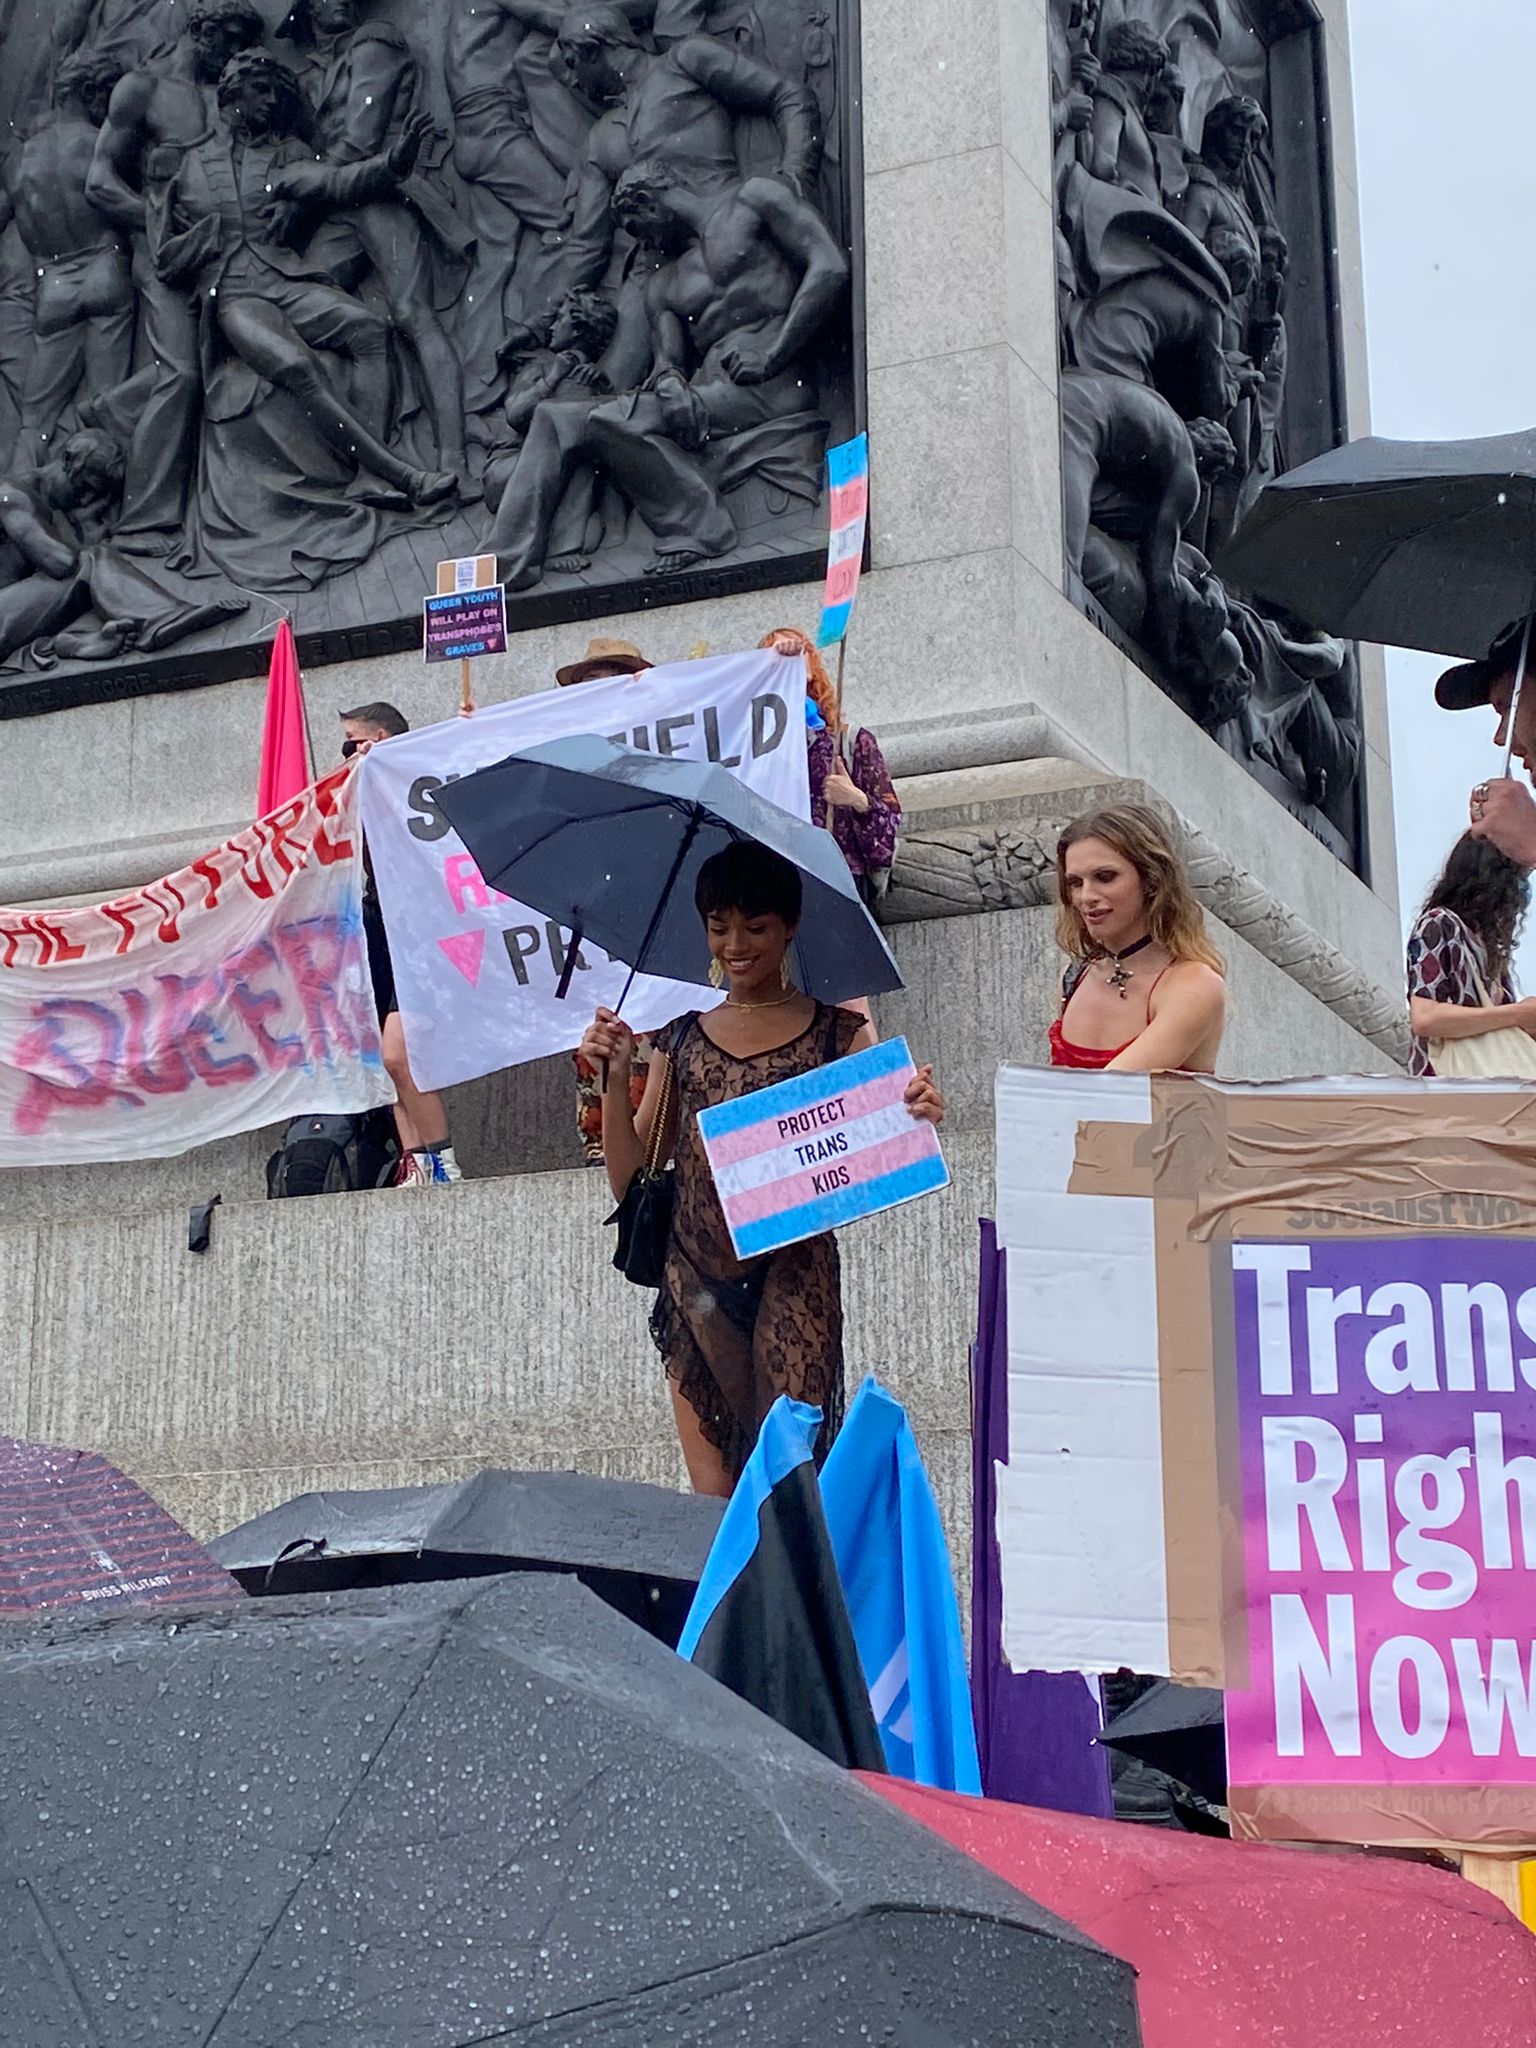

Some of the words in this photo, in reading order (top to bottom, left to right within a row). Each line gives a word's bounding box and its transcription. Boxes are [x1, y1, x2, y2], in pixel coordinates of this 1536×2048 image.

[430, 597, 461, 611] QUEER
[465, 591, 498, 604] YOUTH
[431, 615, 454, 626] WILL
[457, 610, 480, 622] PLAY
[483, 607, 498, 618] ON
[445, 641, 486, 656] GRAVES
[101, 767, 354, 954] FUTURE
[777, 1098, 847, 1139] PROTECT
[795, 1132, 849, 1167] TRANS
[811, 1166, 851, 1196] KIDS
[121, 1575, 171, 1593] MILITARY
[1270, 1594, 1536, 1759] Now
